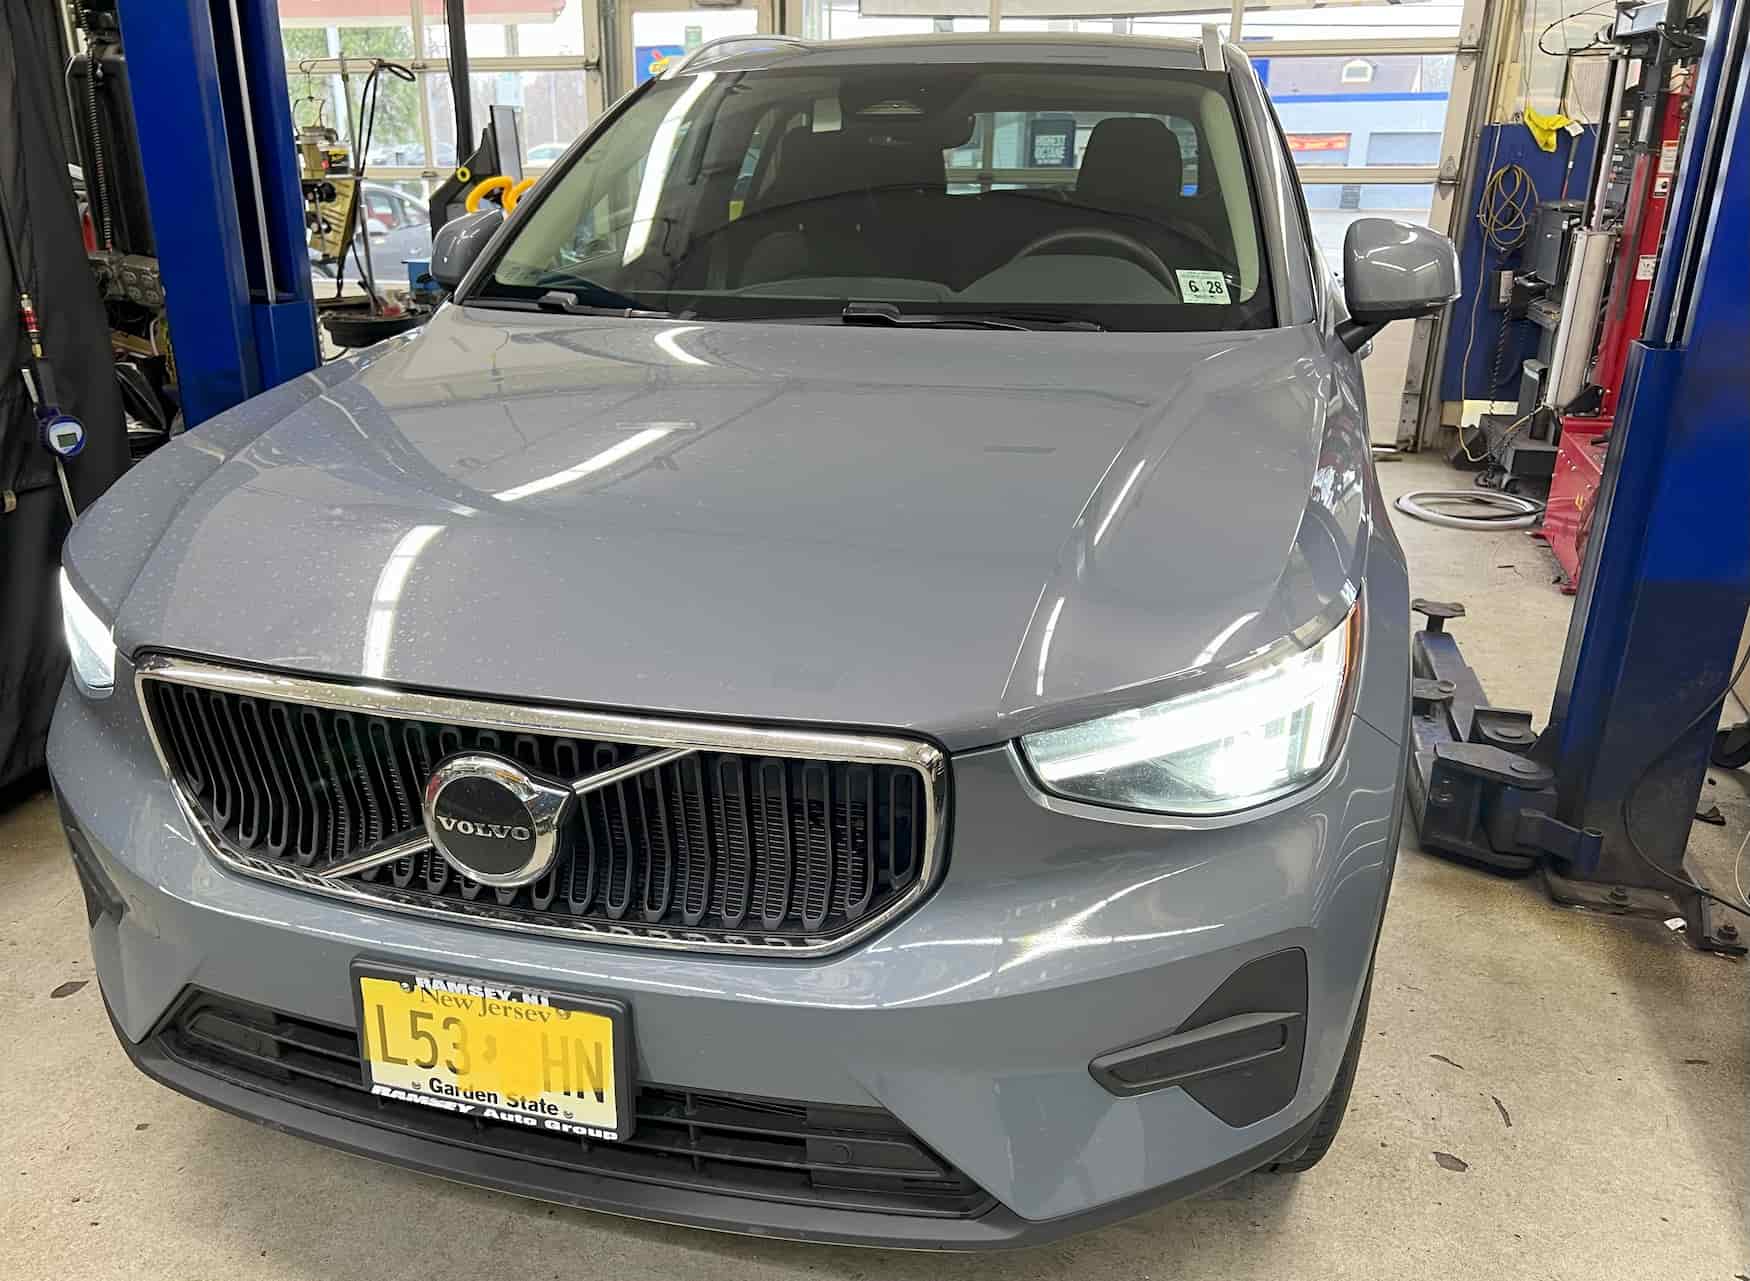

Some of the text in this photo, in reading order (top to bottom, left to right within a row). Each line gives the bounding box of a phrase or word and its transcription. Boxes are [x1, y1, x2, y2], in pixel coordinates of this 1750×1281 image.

[1189, 280, 1223, 294] 6 28
[437, 815, 531, 841] VOLVO
[420, 988, 552, 1023] New Jersey
[376, 1004, 472, 1076] L53
[429, 1077, 559, 1116] Garden State
[483, 1108, 538, 1126] Auto
[544, 1119, 618, 1140] Group
